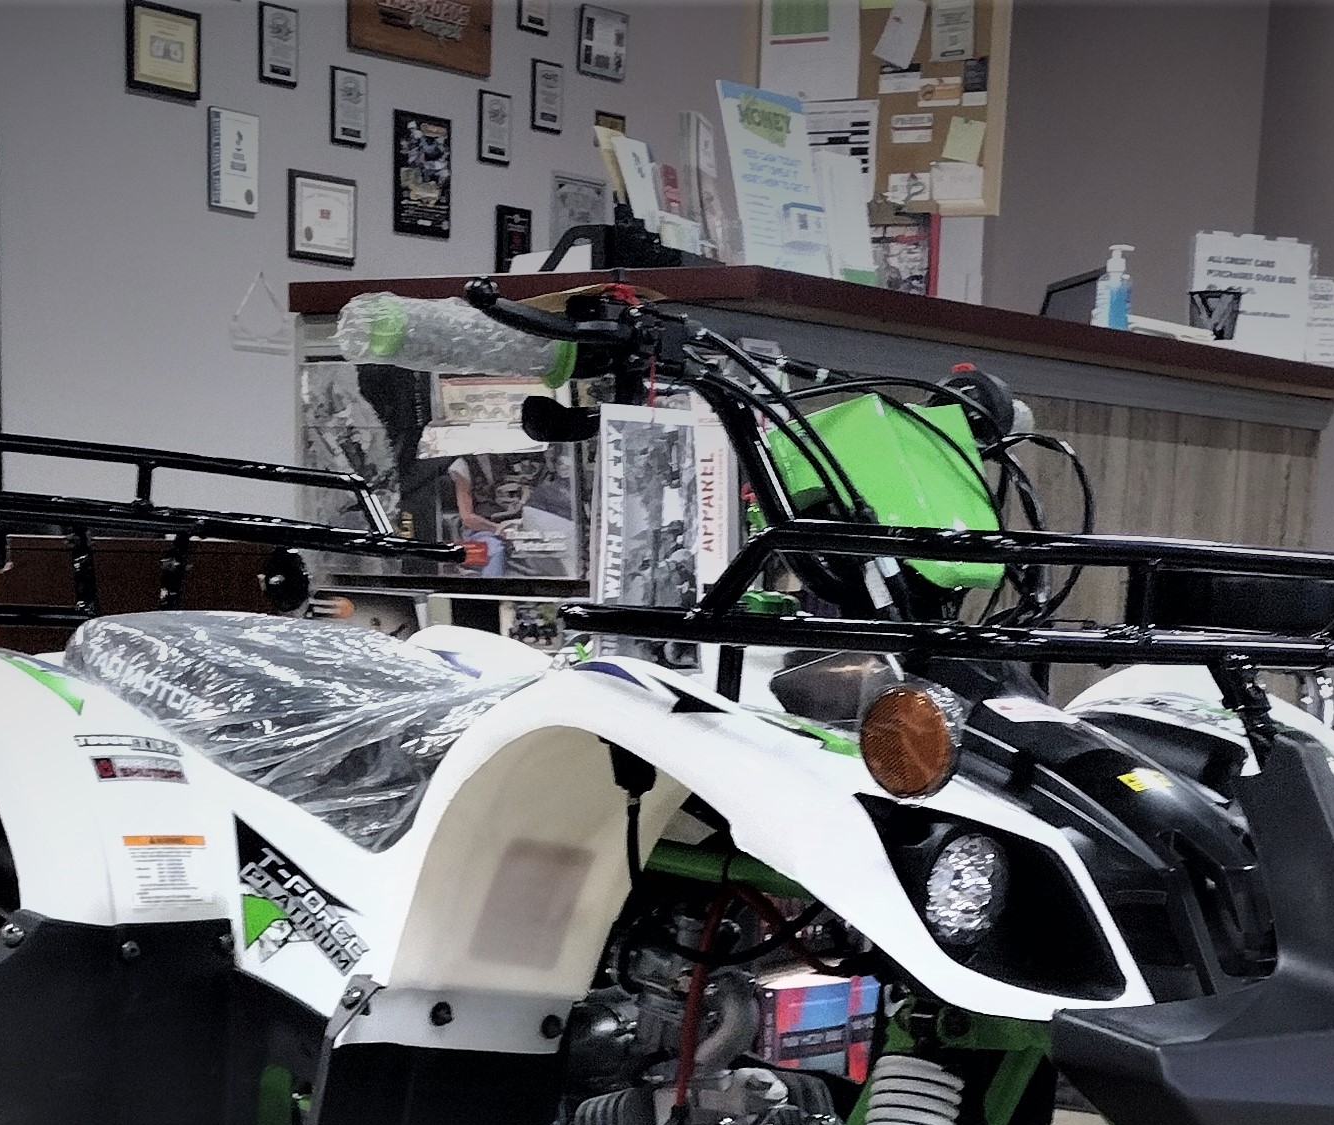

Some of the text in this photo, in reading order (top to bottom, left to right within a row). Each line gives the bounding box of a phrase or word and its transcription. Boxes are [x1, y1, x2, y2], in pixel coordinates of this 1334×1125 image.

[603, 426, 624, 599] WITH SAFETY
[700, 455, 715, 552] APPAREL
[239, 862, 353, 976] PLATINUM
[258, 847, 370, 961] T-FORCE
